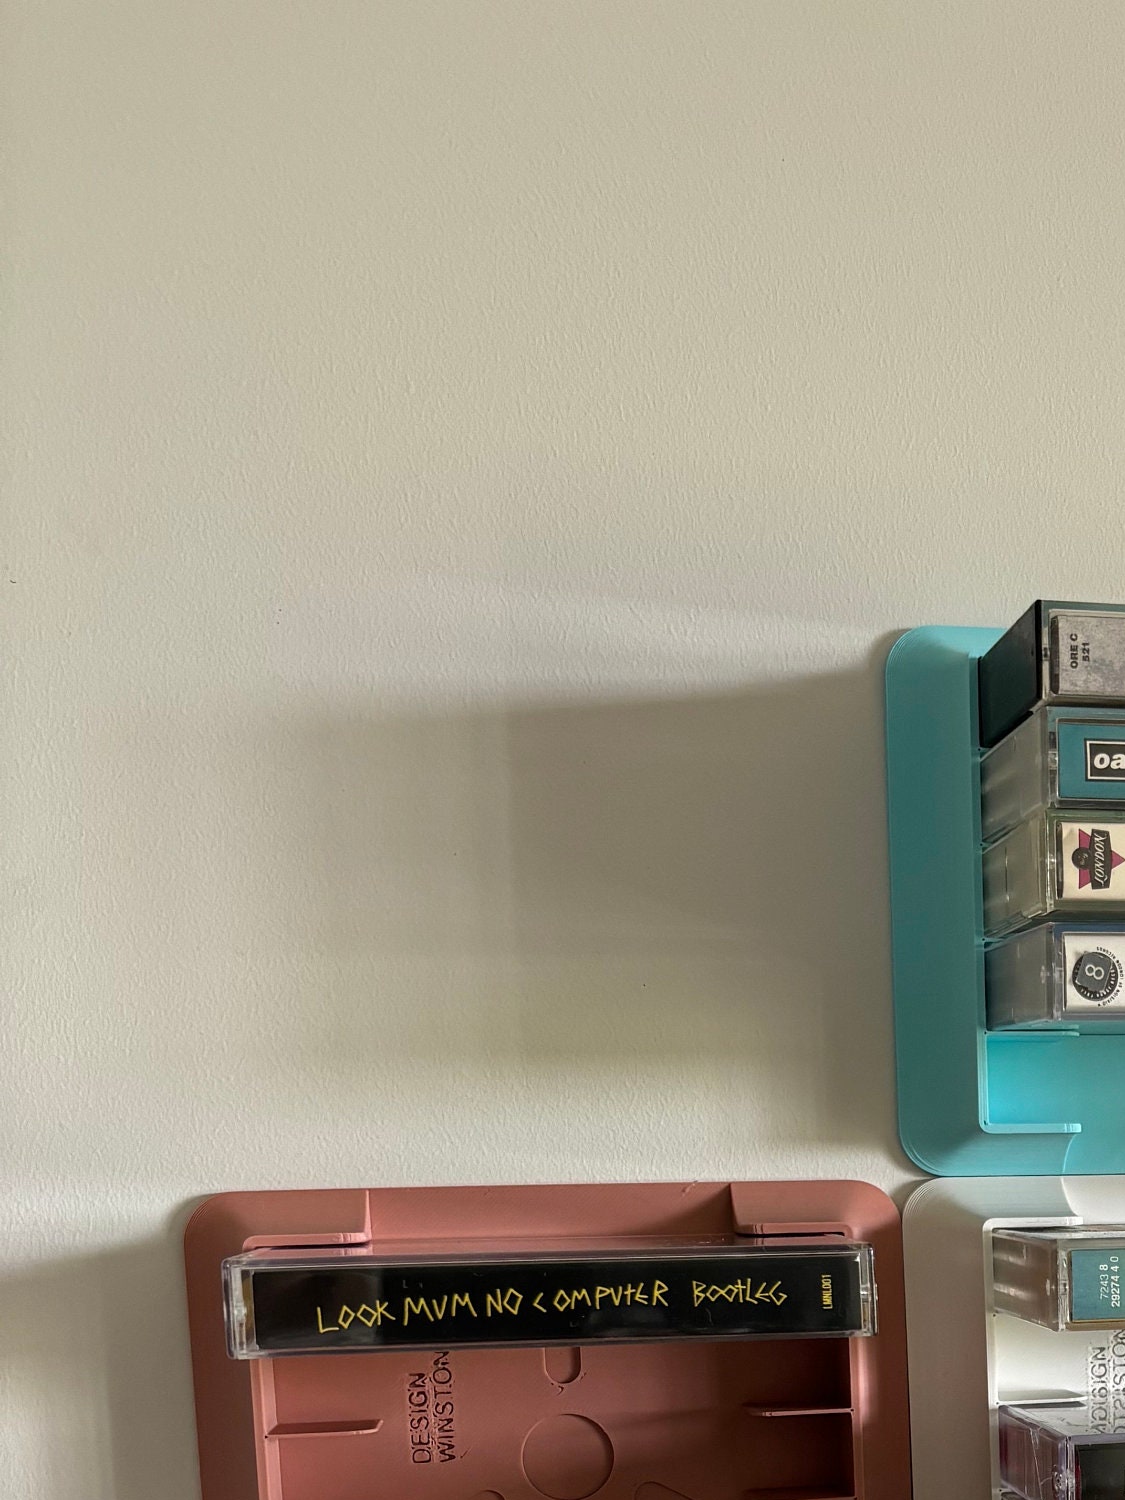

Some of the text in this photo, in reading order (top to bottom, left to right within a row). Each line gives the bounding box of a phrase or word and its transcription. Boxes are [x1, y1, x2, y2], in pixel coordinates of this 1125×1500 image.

[1070, 641, 1078, 669] ORE
[1082, 642, 1090, 662] 521
[1100, 1274, 1108, 1300] 7243
[1110, 1276, 1121, 1308] 29274
[317, 1278, 788, 1334] LOOK NO BOOTLEG
[408, 1372, 431, 1463] DESIGN
